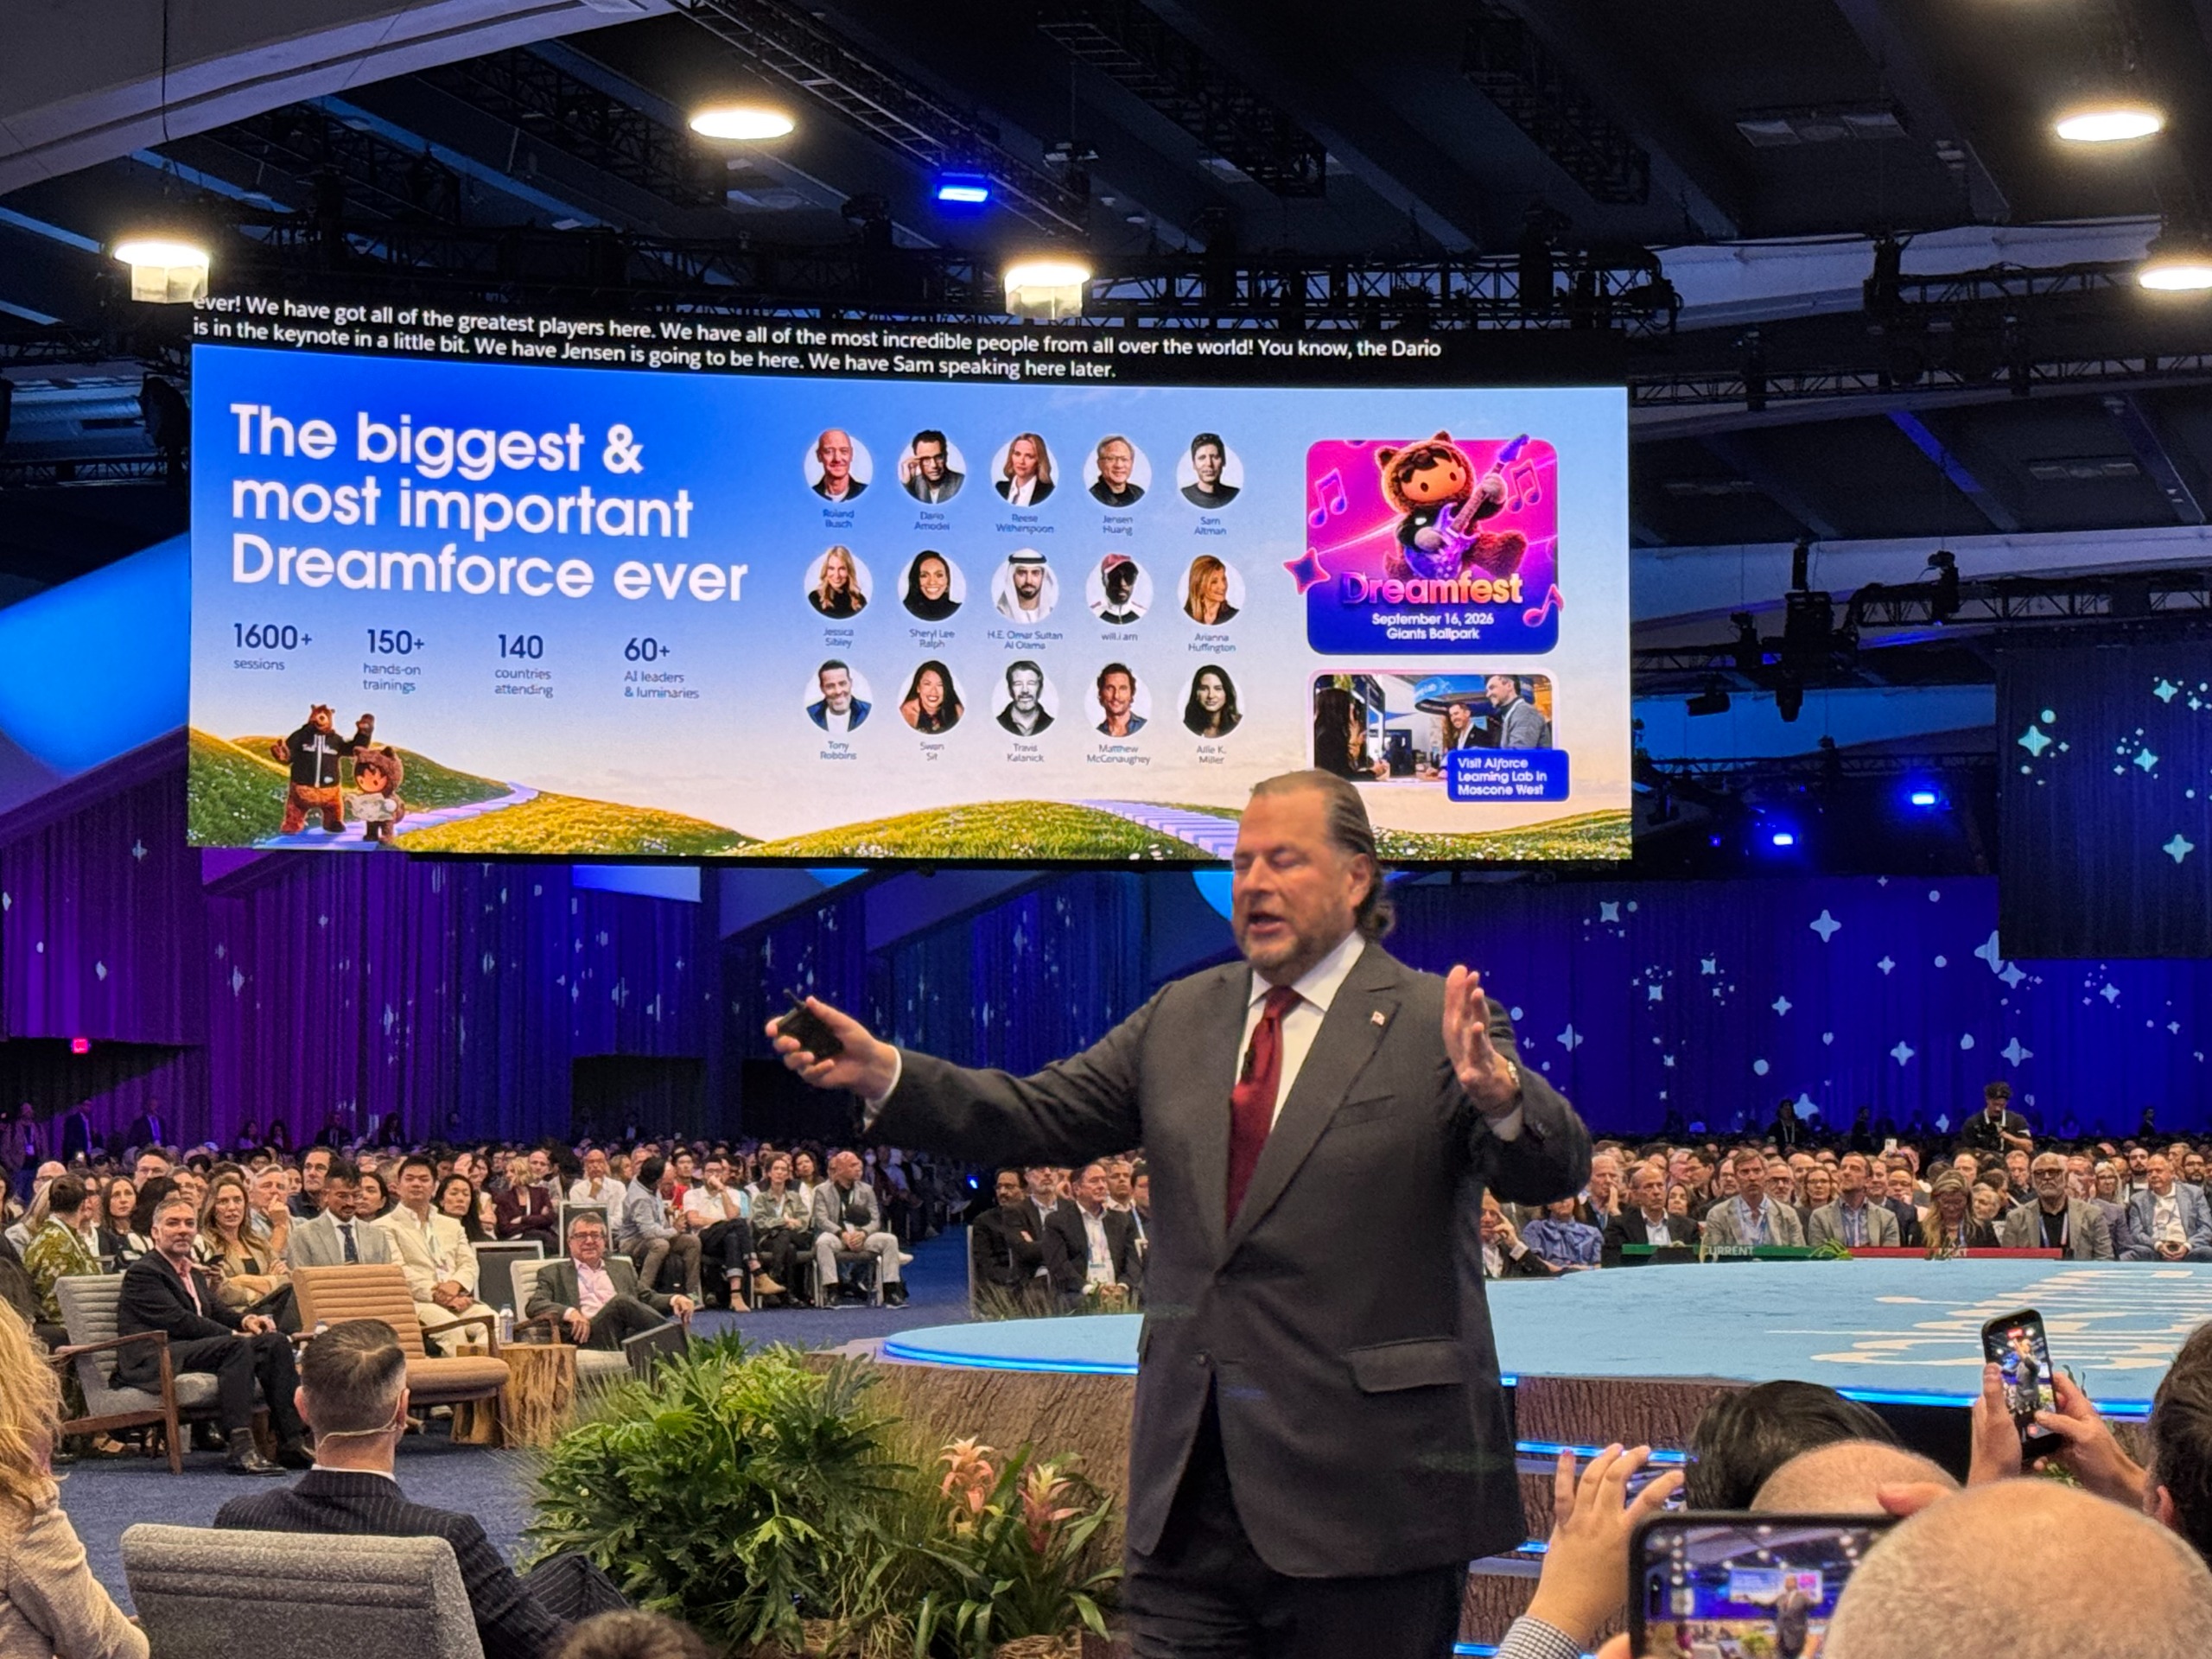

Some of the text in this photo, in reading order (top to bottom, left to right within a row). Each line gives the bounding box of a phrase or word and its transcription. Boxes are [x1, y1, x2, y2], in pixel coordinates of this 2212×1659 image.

[192, 295, 1441, 359] ever! We have got all of the greatest players here. We have all of the most incredible people from all over the world! You know, the Dario
[193, 316, 1116, 380] is in the keynote in a little bit. We have Jensen is going to be here. We have Sam speaking here later.
[230, 403, 643, 480] The biggest &
[232, 475, 693, 542] most important
[1200, 517, 1221, 525] Sam
[995, 524, 1054, 535] Witherspoon
[1103, 526, 1133, 537] Huang
[1194, 526, 1226, 535] Altman
[232, 532, 747, 601] Dreamforce ever
[1342, 570, 1523, 604] Dreamfest
[1371, 613, 1494, 626] September 16, 2026
[233, 623, 313, 650] 1600+
[823, 627, 854, 637] Jessica
[909, 628, 955, 640] Sheryl Lee
[1007, 630, 1033, 639] Omar
[1034, 631, 1063, 640] Sultan
[1194, 632, 1230, 641] Arianna
[1386, 627, 1480, 641] Giants Ballpark
[367, 629, 424, 655] 150+
[498, 634, 543, 659] 140
[919, 639, 944, 650] Ralph
[624, 638, 671, 662] 60+
[1188, 643, 1236, 654] Huffington
[233, 658, 285, 671] sessions
[363, 663, 421, 676] hands-on
[495, 668, 551, 680] countries
[624, 671, 684, 683] AI leaders
[363, 678, 416, 695] trainings
[495, 683, 554, 699] attending
[624, 686, 700, 699] & luminaries
[828, 741, 849, 752] Tony
[1013, 743, 1038, 752] Travis
[1098, 744, 1139, 753] Matthew
[1197, 745, 1215, 753] Allie
[820, 751, 856, 760] Robbins
[1007, 753, 1044, 762] Kalanick
[1087, 753, 1151, 766] McConaughey
[1198, 755, 1224, 764] Miller
[1458, 757, 1482, 768] Visit
[1458, 770, 1548, 784] Learning Lab in
[1458, 784, 1543, 795] Moscone West
